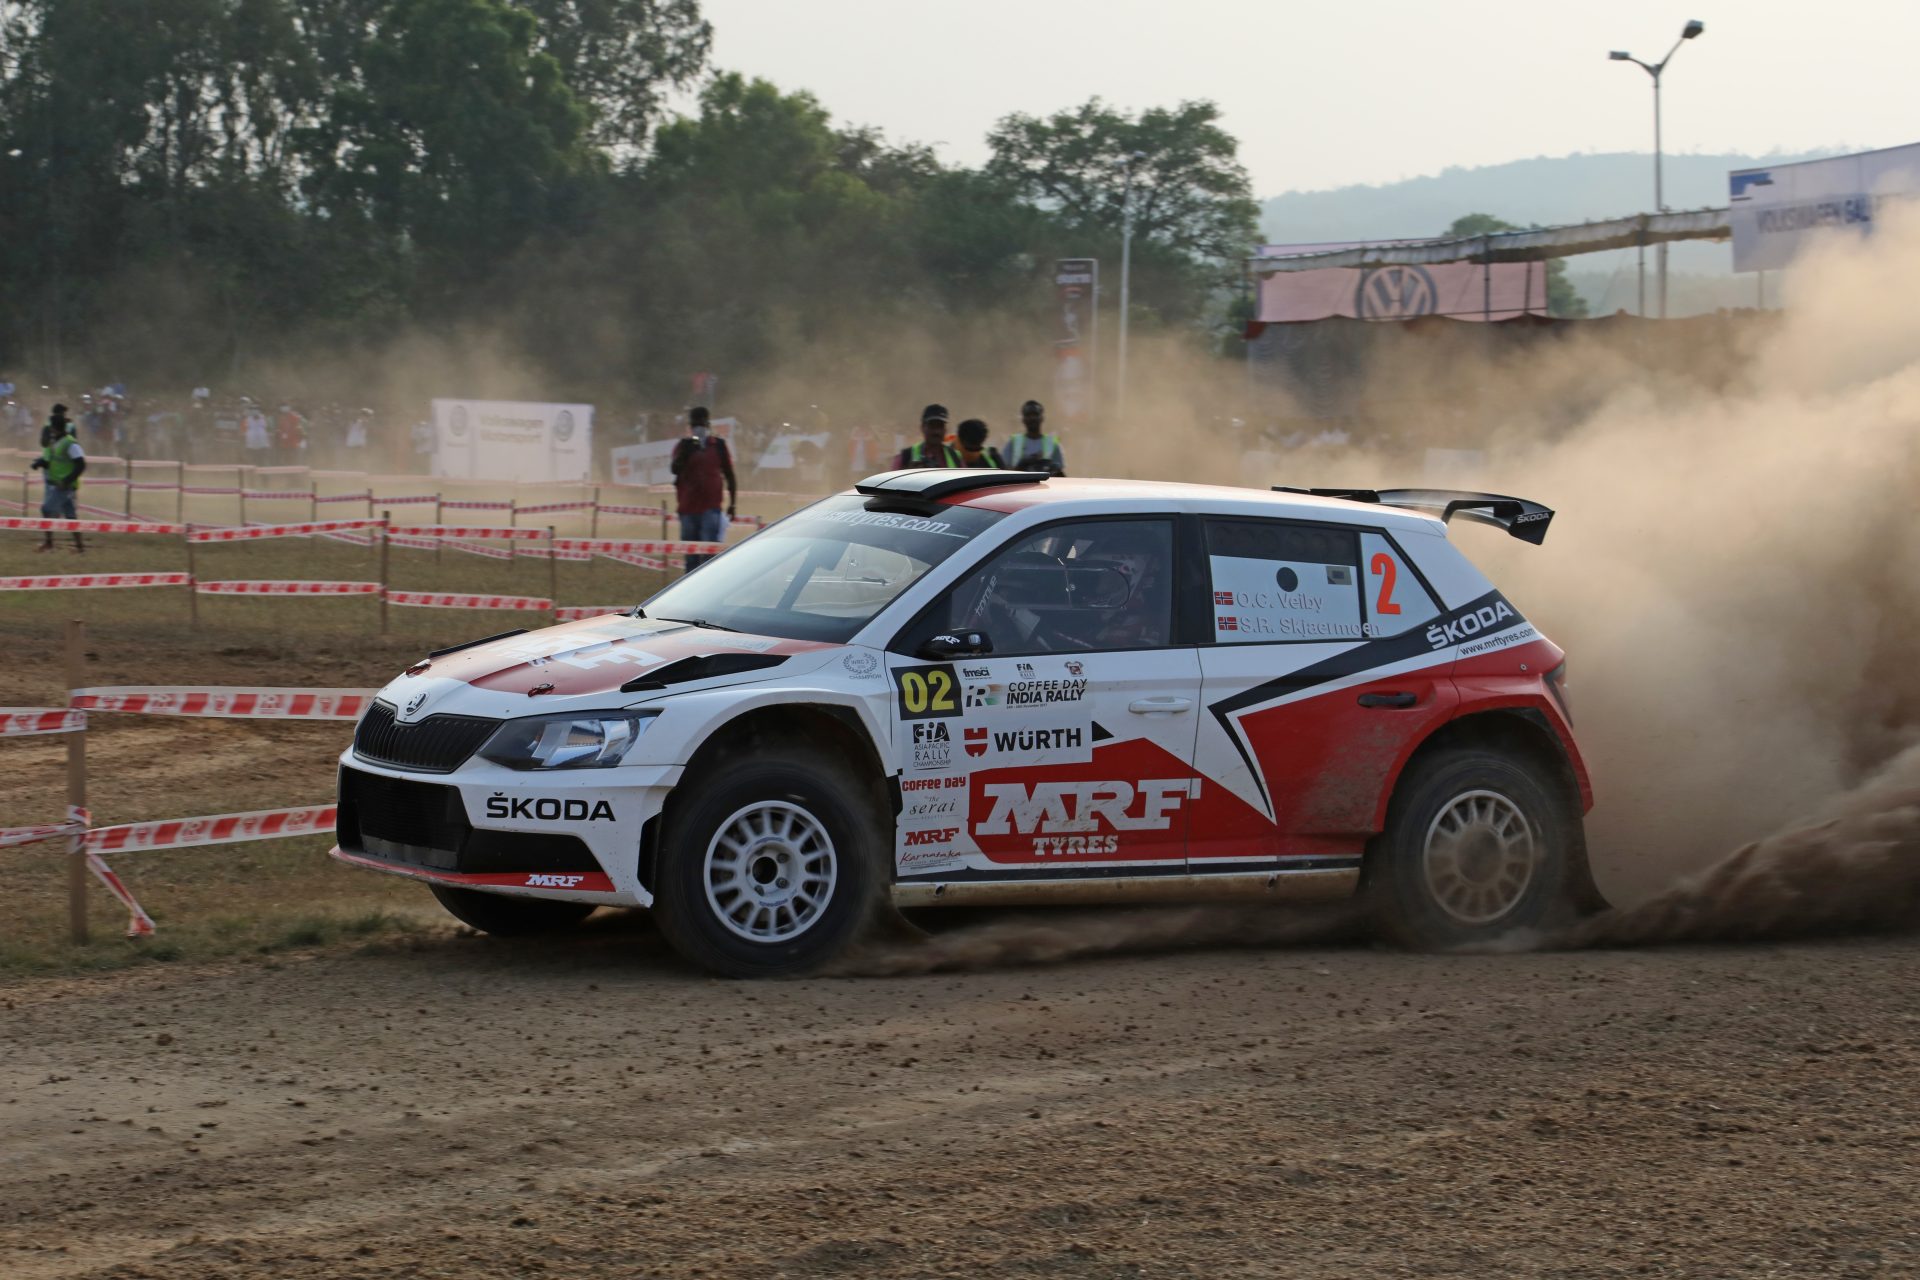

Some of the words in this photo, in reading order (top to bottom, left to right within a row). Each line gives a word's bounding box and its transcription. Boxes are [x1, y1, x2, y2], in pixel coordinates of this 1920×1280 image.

[1371, 553, 1402, 615] 2
[1277, 592, 1322, 613] Veiby
[1426, 601, 1514, 650] ŠKODA
[1460, 627, 1536, 656] www.mrftyres.com
[901, 670, 955, 713] 02
[1006, 691, 1043, 705] INDIA
[1045, 688, 1086, 703] RALLY
[1008, 680, 1059, 692] COFFEE
[1062, 678, 1088, 690] DAY
[993, 727, 1082, 752] WÜRTH
[914, 749, 950, 761] RALLY
[486, 792, 616, 822] ŠKODA
[975, 777, 1202, 835] MRF
[904, 827, 960, 847] MRF
[1032, 834, 1119, 856] TYRES
[525, 874, 584, 887] MRF
